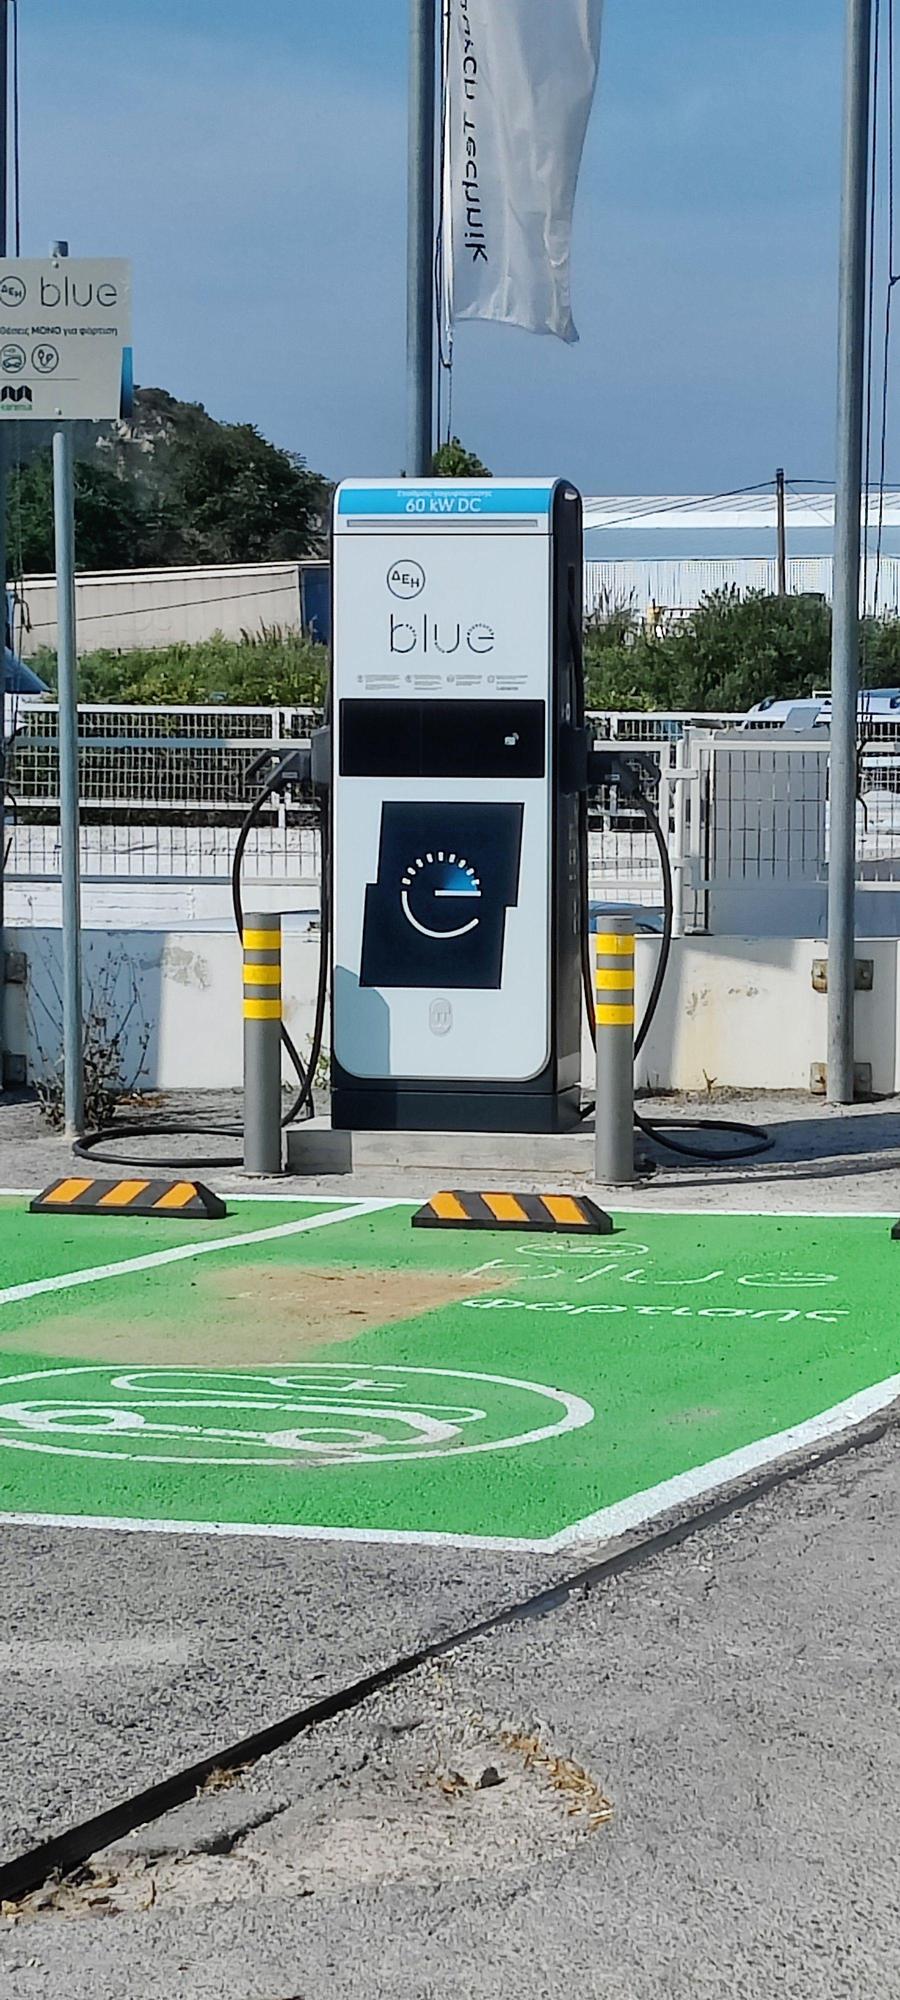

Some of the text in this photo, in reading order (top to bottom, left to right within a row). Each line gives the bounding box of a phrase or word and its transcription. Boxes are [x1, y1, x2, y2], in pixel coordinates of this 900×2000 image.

[40, 276, 118, 307] blue
[63, 328, 78, 336] για
[405, 498, 482, 513] 60 kW DC
[391, 570, 420, 588] ΔΕΗ
[390, 613, 495, 654] blue
